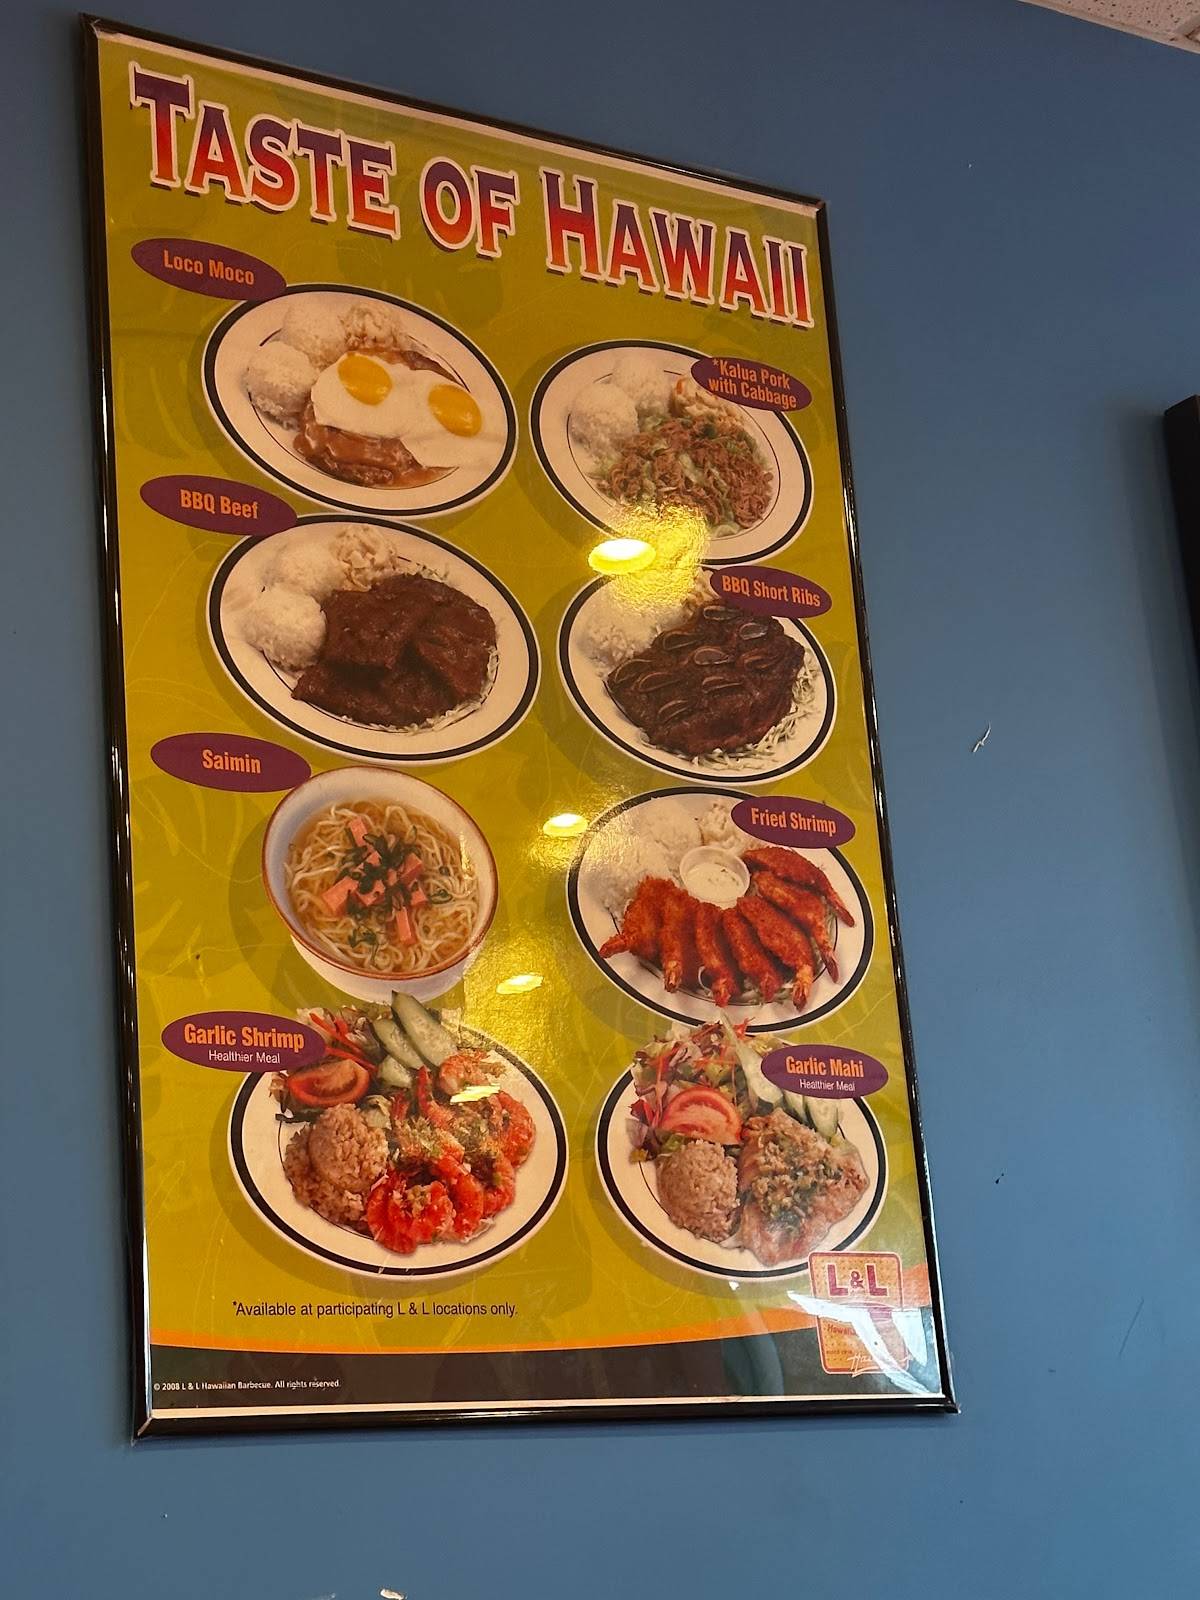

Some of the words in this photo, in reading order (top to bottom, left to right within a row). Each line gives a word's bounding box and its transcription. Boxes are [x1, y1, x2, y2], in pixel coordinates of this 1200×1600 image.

[128, 60, 401, 242] TASTE
[420, 156, 520, 260] OF
[539, 166, 815, 330] HAWAII
[163, 249, 203, 275] Loco
[208, 259, 254, 285] Moco
[761, 368, 791, 390] Pork
[708, 376, 737, 396] with
[741, 381, 797, 410] Cabbage
[180, 489, 216, 514] BBQ
[220, 495, 259, 520] Beef
[722, 575, 750, 597] BBQ
[753, 580, 788, 602] Short
[791, 586, 821, 607] Ribs
[202, 749, 262, 774] Saimin
[751, 807, 787, 828] Fried
[789, 811, 837, 837] Shrimp
[184, 1023, 237, 1046] Garlic
[241, 1026, 305, 1053] Shrimp
[208, 1049, 254, 1063] Healthier
[256, 1051, 281, 1064] Meal
[785, 1055, 827, 1076] Garlic
[830, 1056, 865, 1078] Mahi
[799, 1078, 834, 1091] Healthier
[836, 1080, 855, 1092] Meal
[300, 1302, 313, 1316] at
[316, 1301, 394, 1319] participating
[397, 1301, 406, 1315] L
[408, 1301, 418, 1315] &
[422, 1301, 430, 1315] L
[432, 1301, 487, 1315] locations
[490, 1301, 519, 1317] only.
[162, 1383, 181, 1391] 2008
[181, 1382, 187, 1391] L
[187, 1382, 194, 1391] &
[195, 1382, 201, 1391] L
[201, 1381, 237, 1390] Hawaiian
[237, 1381, 274, 1390] Barbecue.
[274, 1380, 286, 1389] All
[286, 1380, 308, 1391] rights
